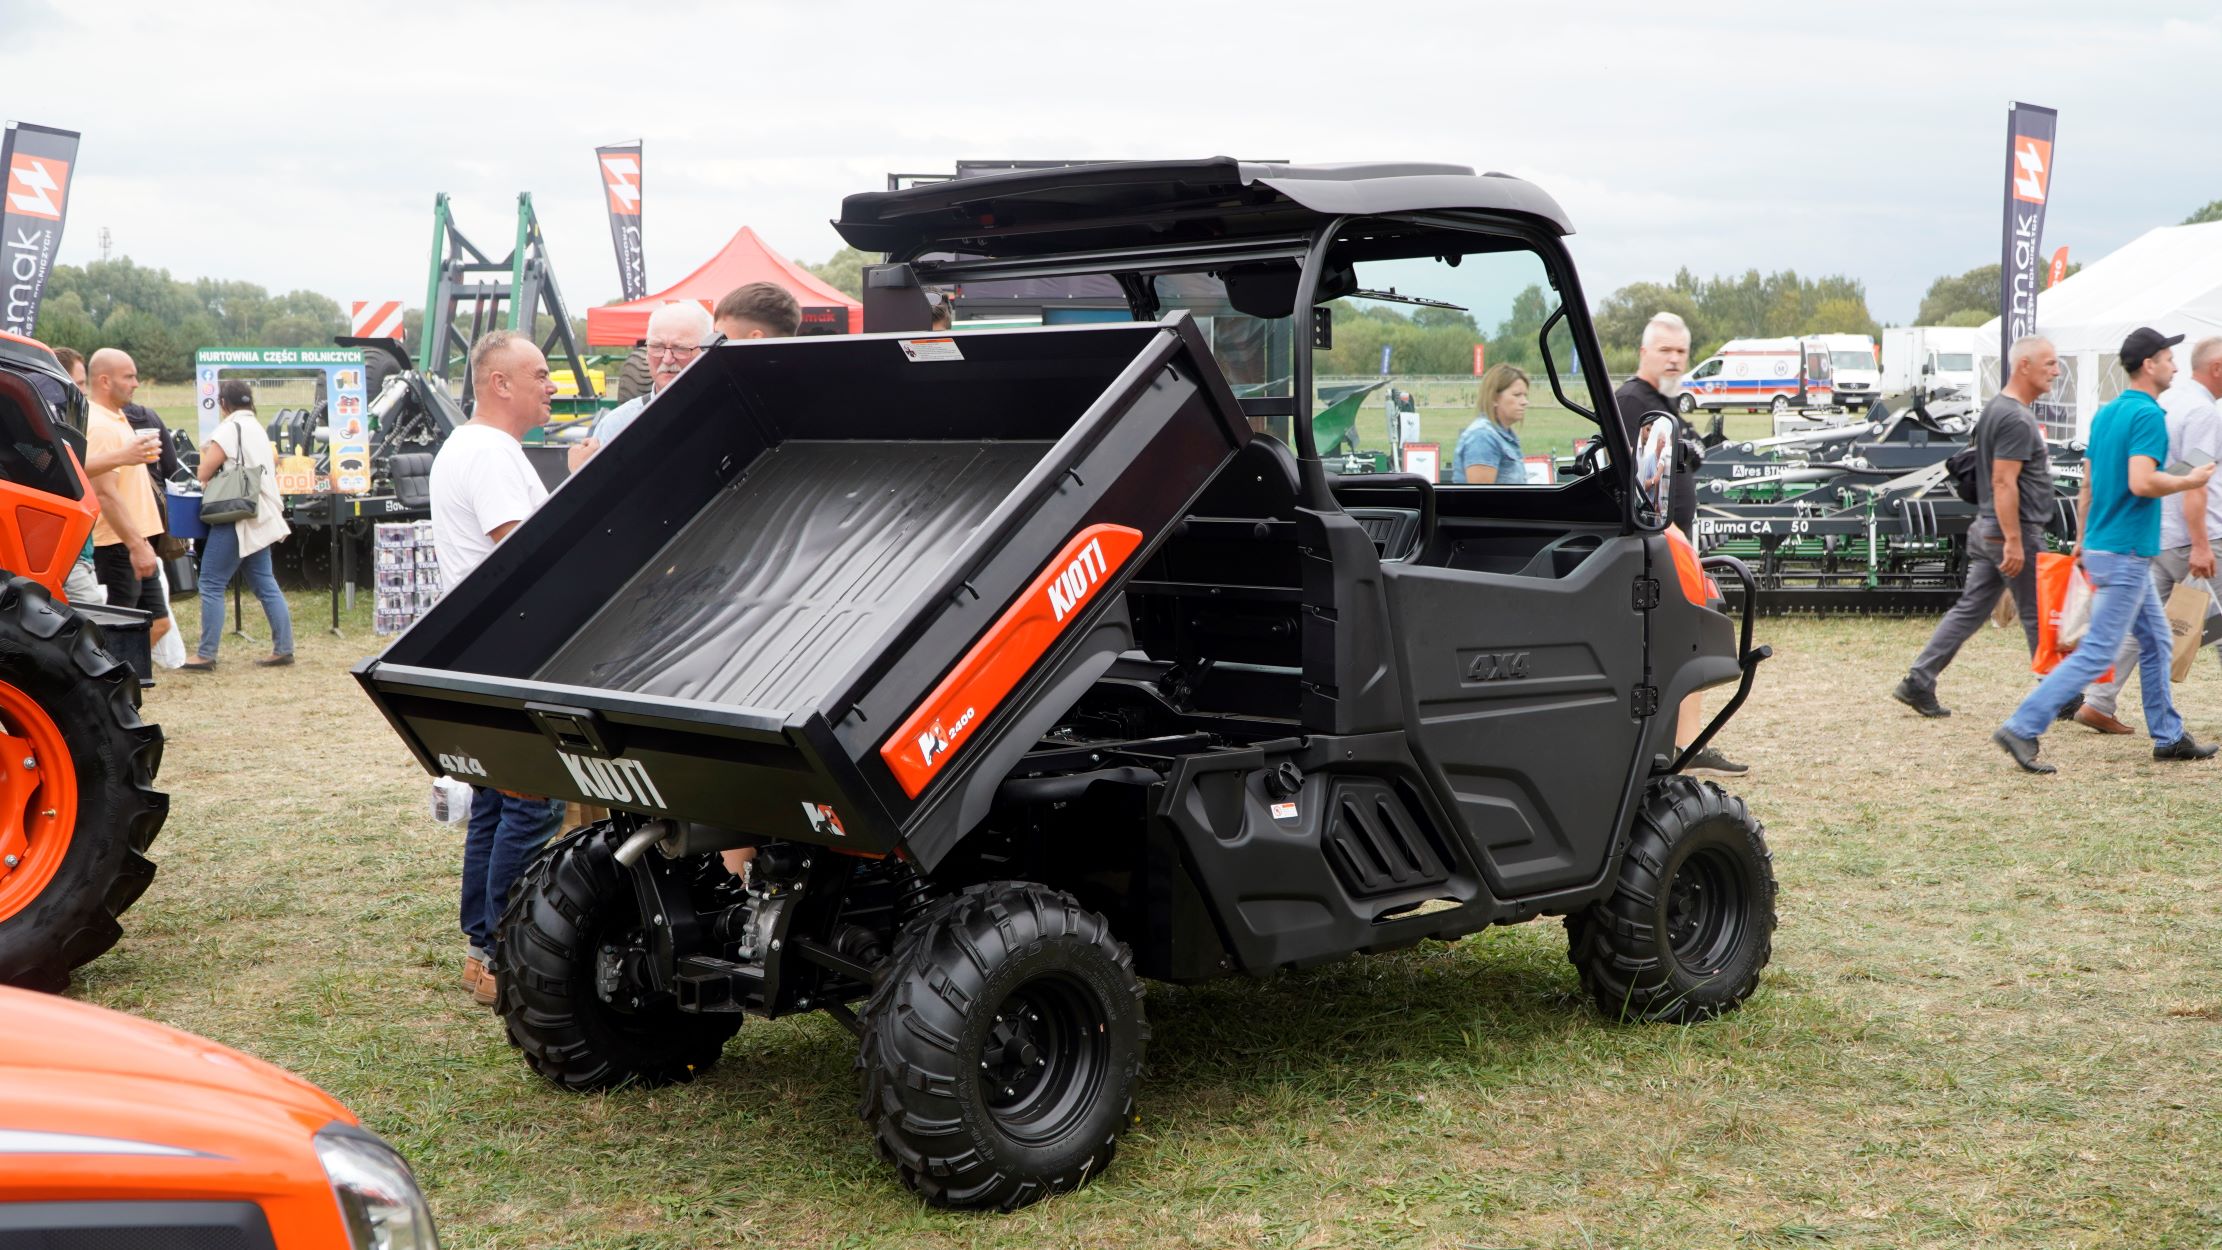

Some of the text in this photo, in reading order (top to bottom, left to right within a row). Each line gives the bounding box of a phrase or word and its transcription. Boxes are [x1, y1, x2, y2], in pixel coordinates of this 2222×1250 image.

[199, 349, 361, 364] HURTOWNIA CZĘŚCI ROLNICZYCH
[1732, 464, 1762, 478] Ares
[1700, 520, 1809, 534] Puma CA 50
[1047, 537, 1107, 623] KIOTI
[1467, 651, 1530, 683] 4X4
[948, 706, 975, 741] 2400
[438, 753, 488, 777] 4X4
[556, 748, 668, 810] KIOTI
